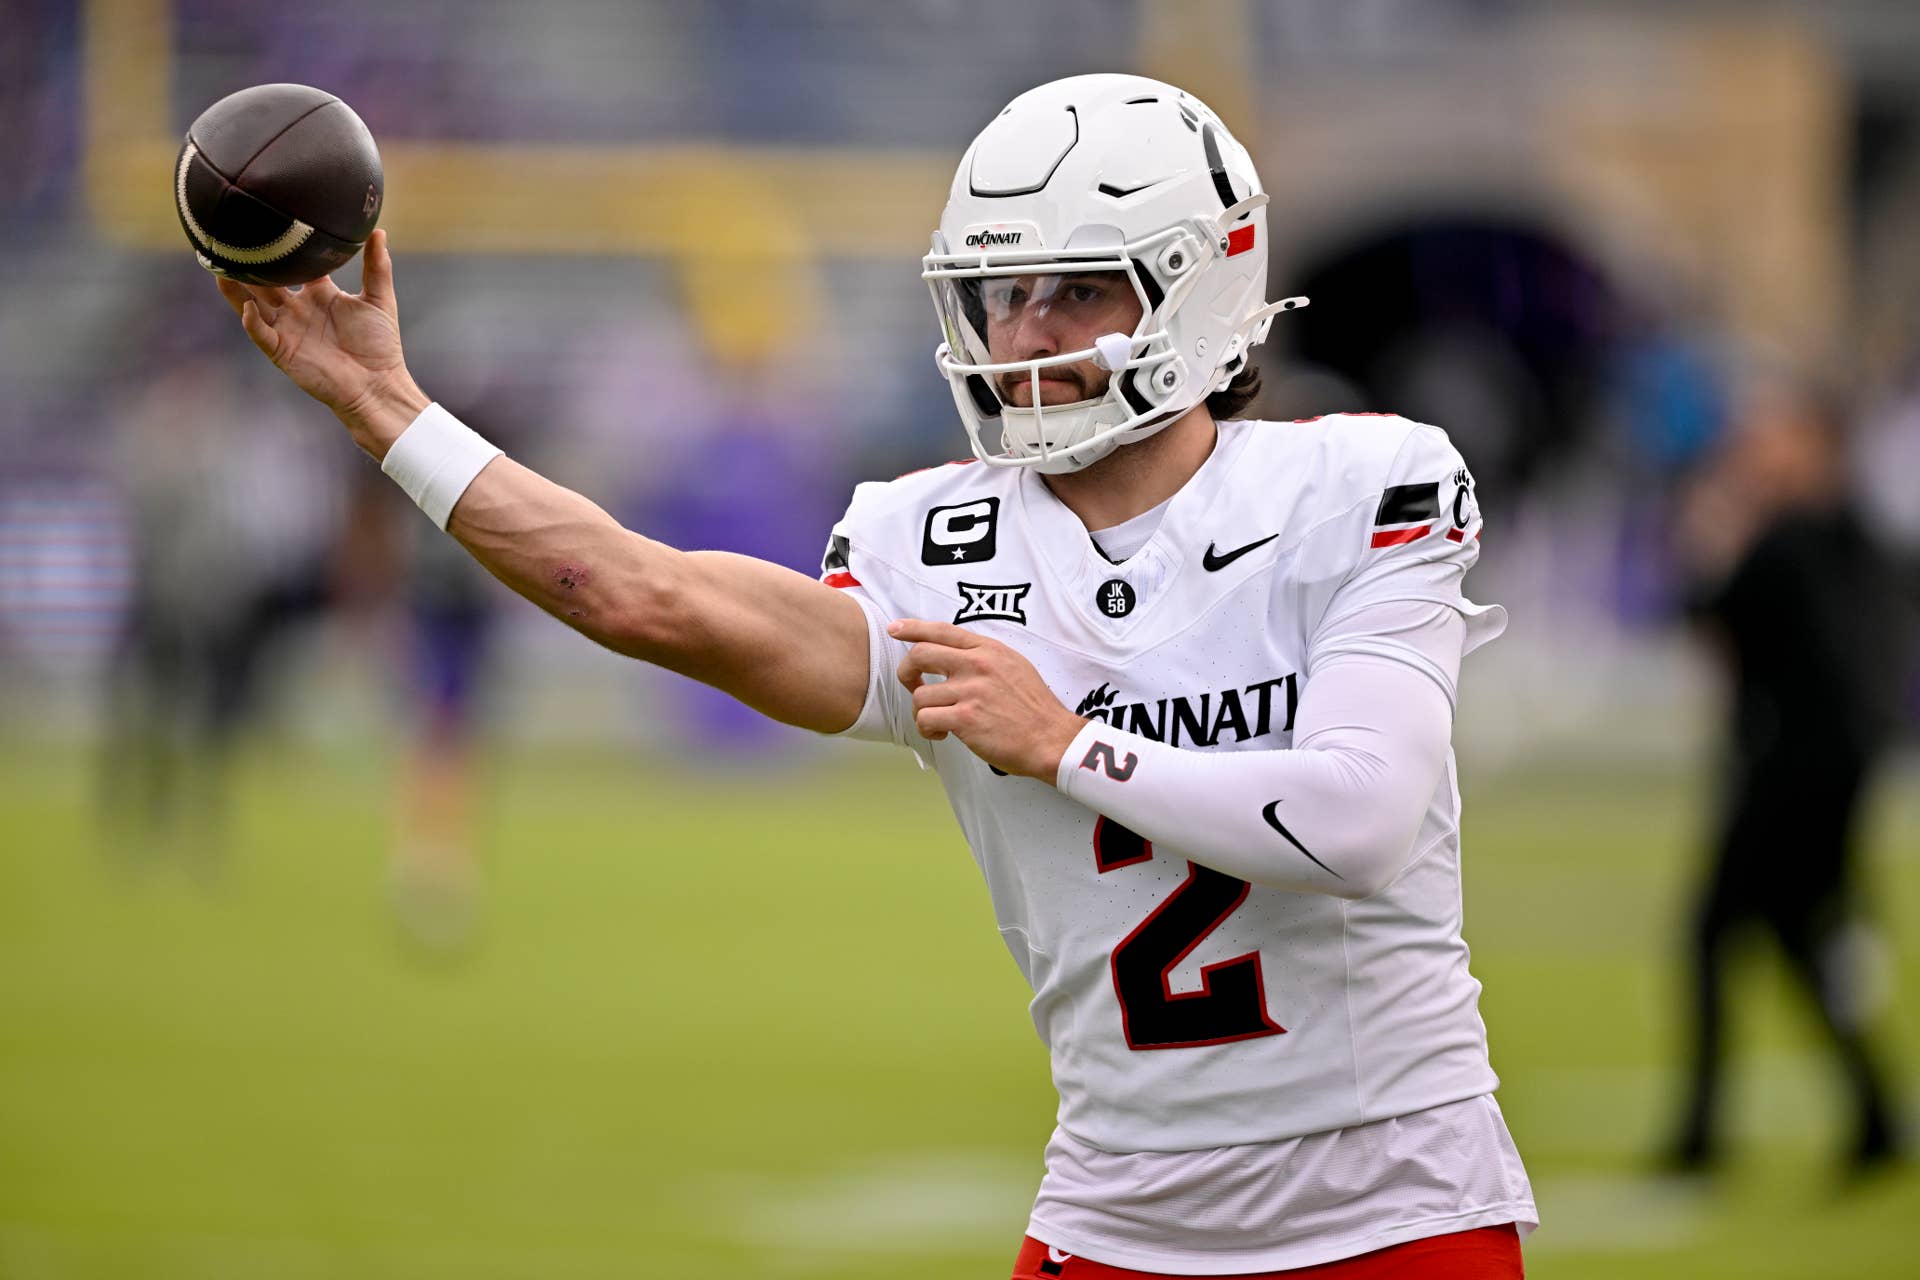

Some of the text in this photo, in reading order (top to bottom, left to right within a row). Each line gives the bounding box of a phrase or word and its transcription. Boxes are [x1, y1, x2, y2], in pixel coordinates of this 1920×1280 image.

[965, 230, 1021, 248] CINCINNATI
[930, 502, 991, 546] C
[1107, 583, 1124, 598] JK
[1107, 598, 1126, 614] 58
[1078, 740, 1138, 782] 2
[1093, 813, 1288, 1050] 2
